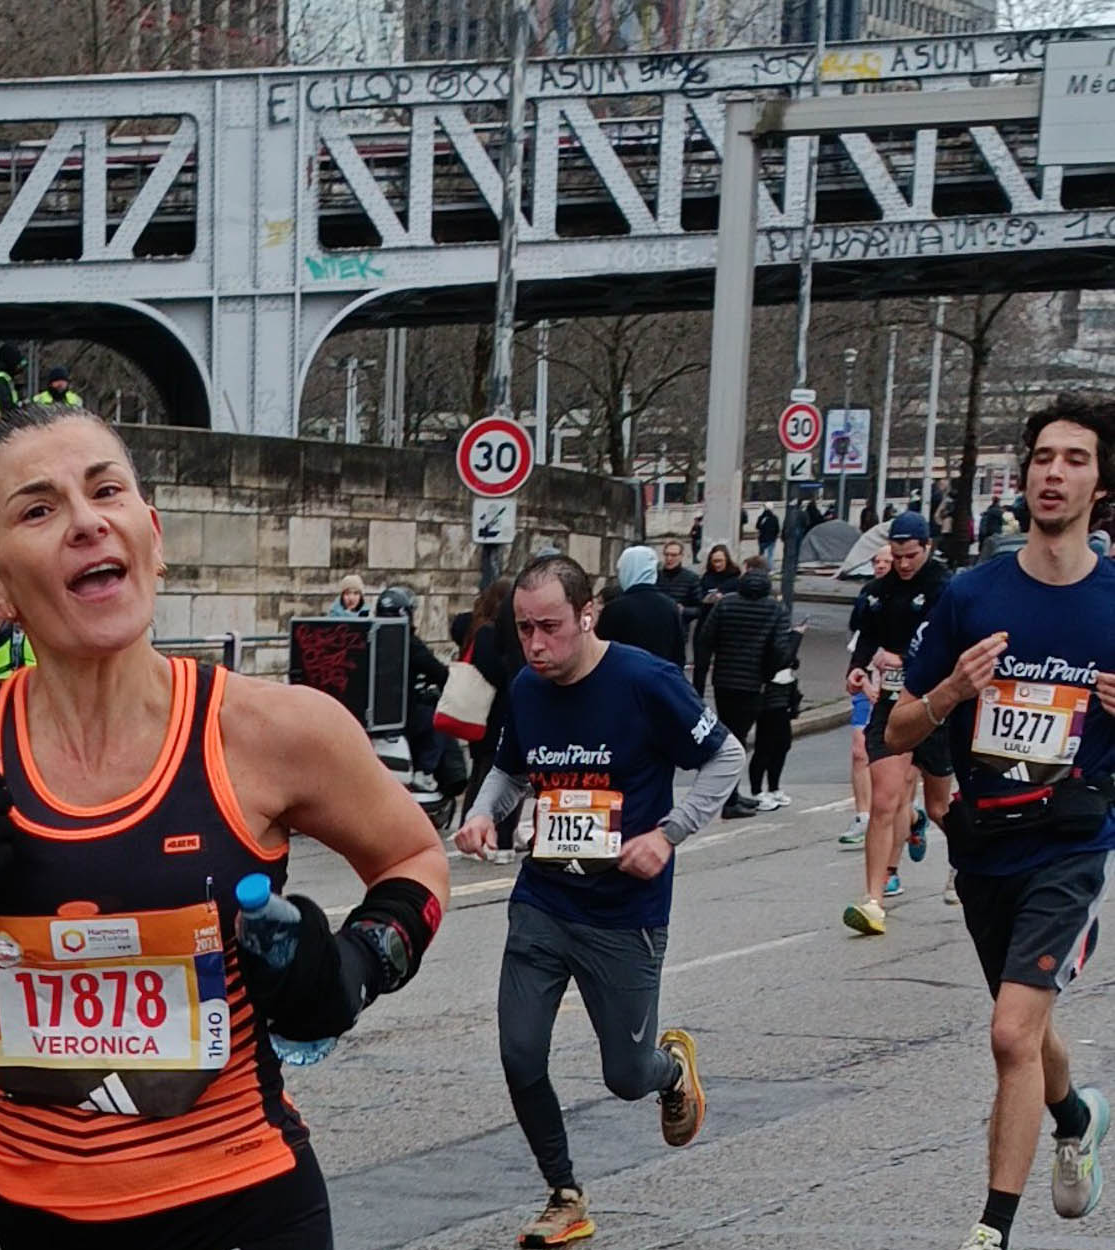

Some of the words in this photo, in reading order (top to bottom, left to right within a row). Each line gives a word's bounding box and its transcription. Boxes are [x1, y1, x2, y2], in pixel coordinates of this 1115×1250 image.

[891, 41, 978, 72] ASUM
[540, 60, 629, 96] ASUM
[789, 417, 812, 437] 30
[474, 441, 518, 473] 30
[991, 706, 1055, 744] 19277
[526, 744, 613, 766] #SemiParis
[547, 815, 595, 841] 21152
[15, 970, 167, 1028] 17878
[32, 1035, 160, 1055] VERONICA
[207, 1012, 223, 1058] 1h40
